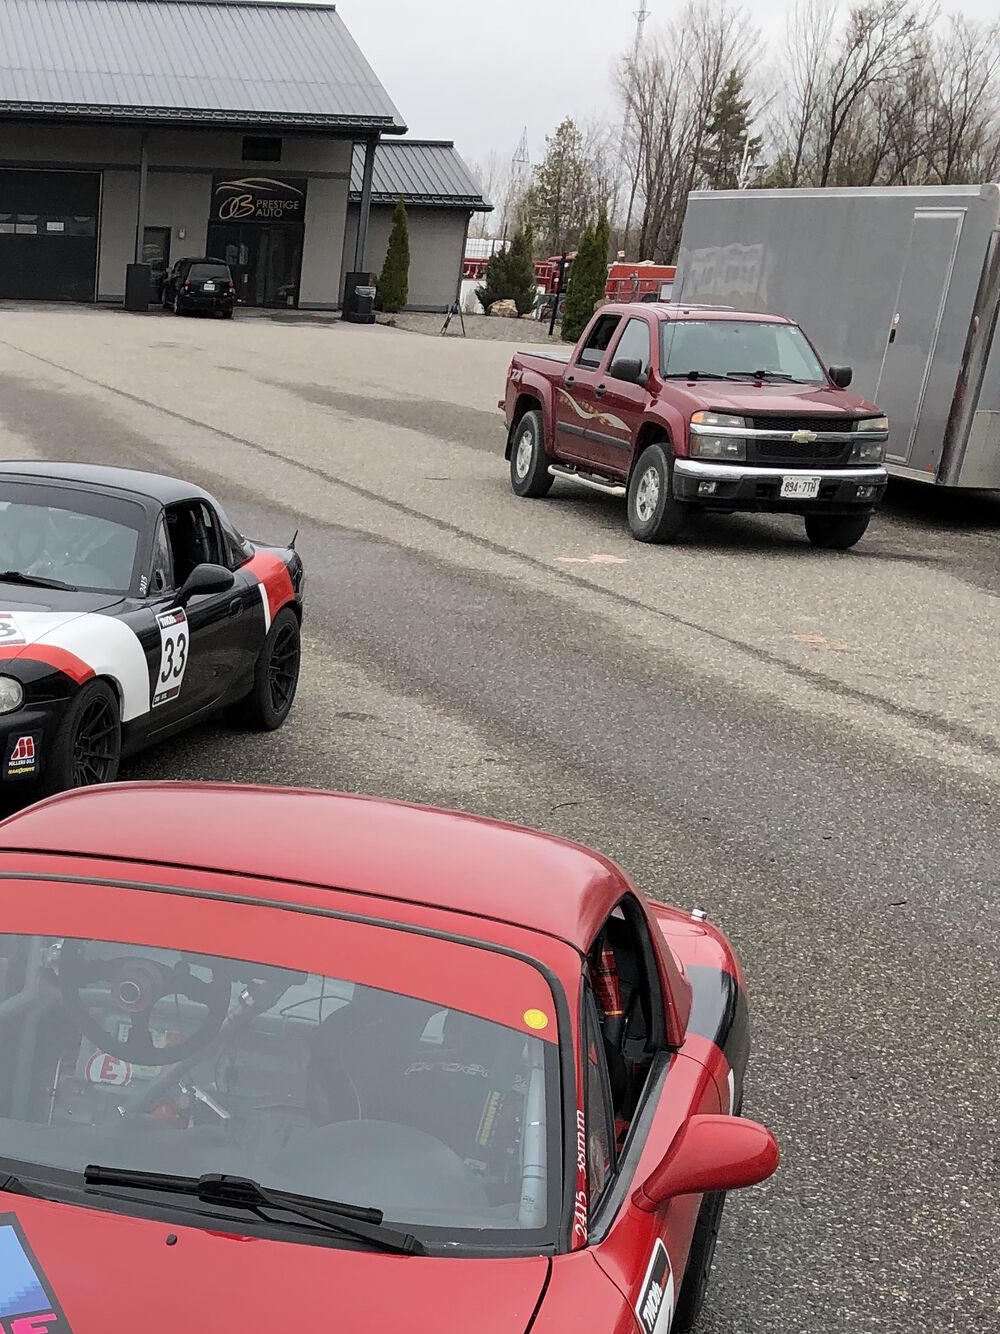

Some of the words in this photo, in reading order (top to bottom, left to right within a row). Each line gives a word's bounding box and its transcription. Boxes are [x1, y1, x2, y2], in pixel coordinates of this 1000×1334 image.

[255, 208, 283, 218] AUTO
[256, 200, 300, 210] PRESTIGE
[160, 632, 187, 684] 33
[574, 1190, 588, 1241] 2415
